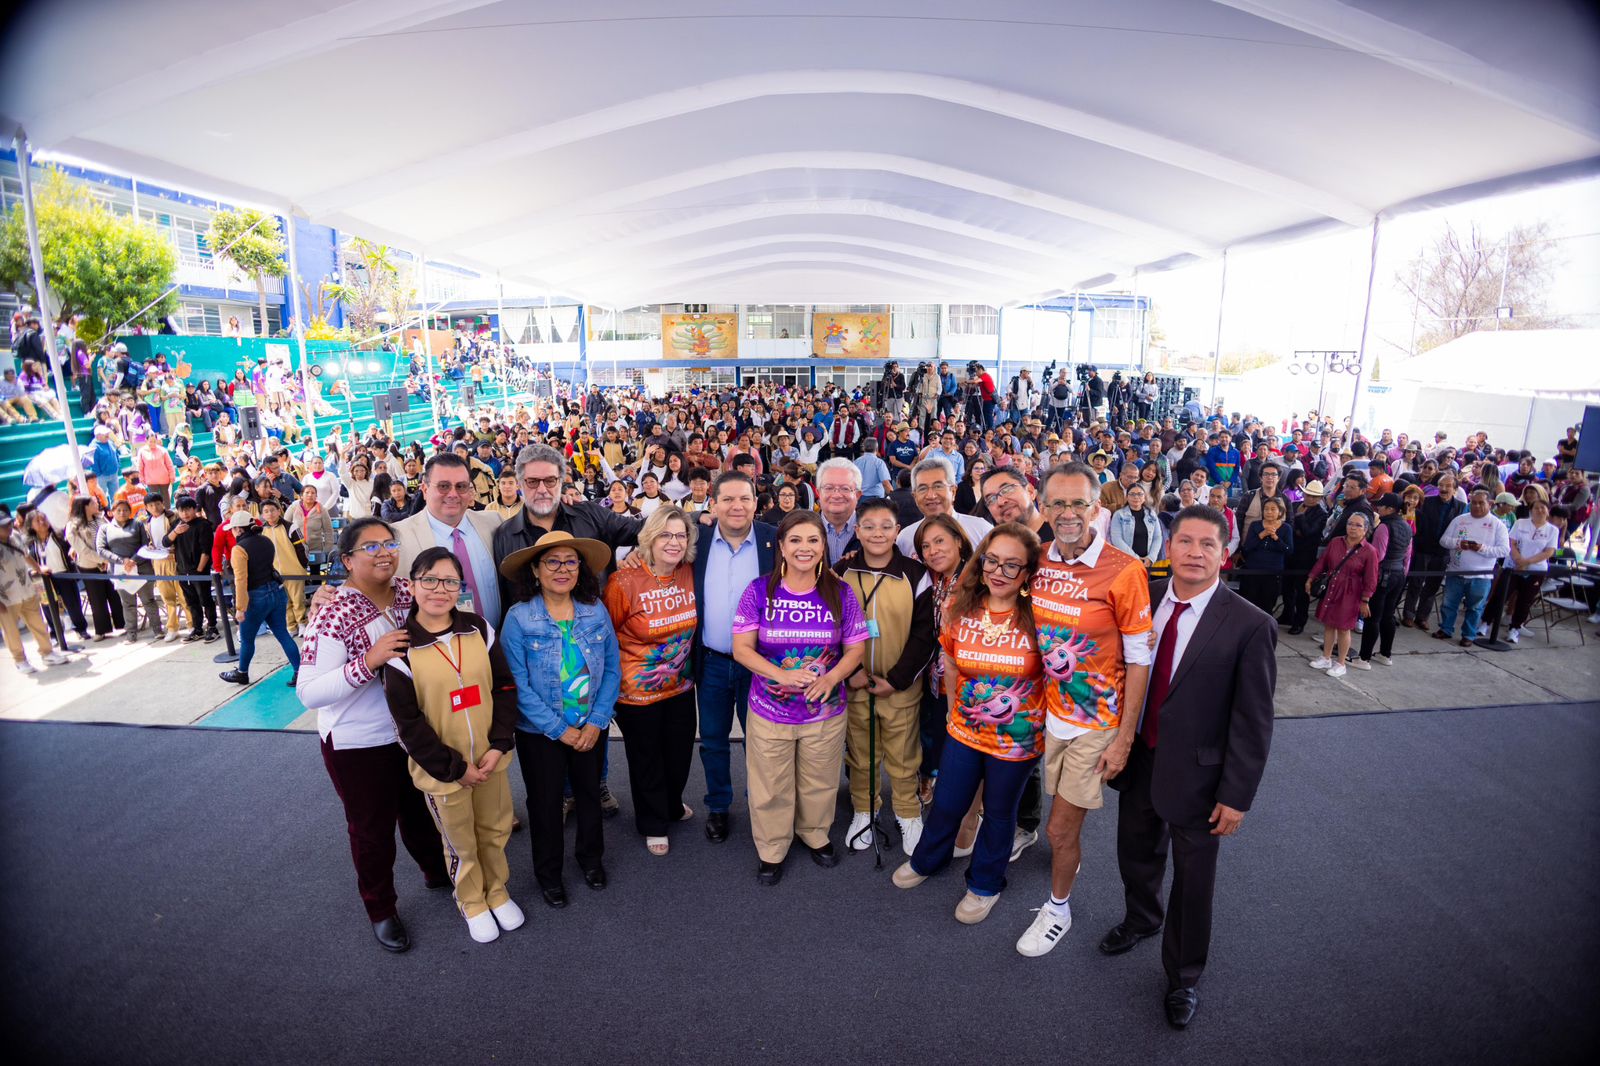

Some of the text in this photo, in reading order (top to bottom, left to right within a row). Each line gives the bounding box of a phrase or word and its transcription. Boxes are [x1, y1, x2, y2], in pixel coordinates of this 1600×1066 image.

[649, 609, 698, 629] SECUNDARIA
[766, 630, 832, 639] SECUNDARIA
[957, 649, 1025, 666] SECUNDARIA
